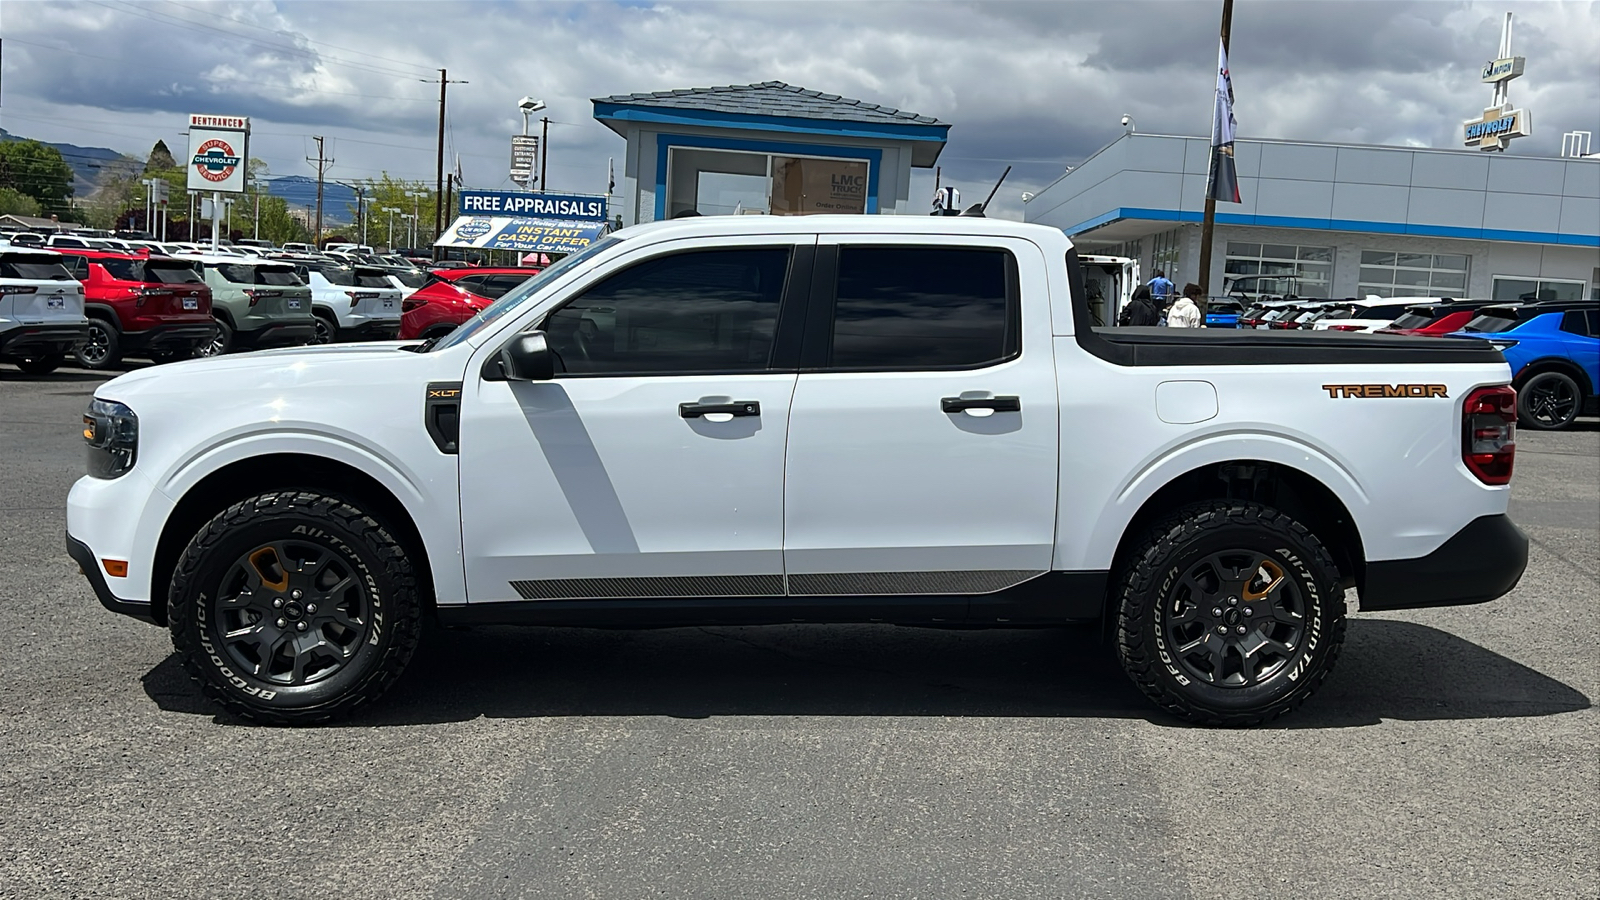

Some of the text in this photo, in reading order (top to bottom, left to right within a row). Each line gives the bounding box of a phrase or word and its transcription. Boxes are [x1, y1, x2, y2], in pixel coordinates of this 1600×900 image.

[198, 117, 237, 127] ENTRANCE
[1465, 116, 1515, 140] CHEVROLET
[203, 141, 230, 152] SUPER
[195, 157, 236, 165] CHEVROLET
[200, 168, 231, 181] SERVICE
[832, 174, 863, 186] LMC
[832, 185, 862, 193] TRUCK
[464, 196, 602, 218] FREE APPRAISALS!
[516, 226, 583, 237] INSTANT
[497, 233, 539, 243] CASH
[541, 237, 590, 247] OFFER
[429, 389, 460, 397] XLT
[1322, 384, 1450, 399] TREMOR
[291, 524, 383, 646] All-Terrain T/A
[1274, 548, 1321, 682] All-Terrain T/A
[1154, 565, 1191, 687] BFGoodrich
[196, 592, 277, 701] BFGoodrich
